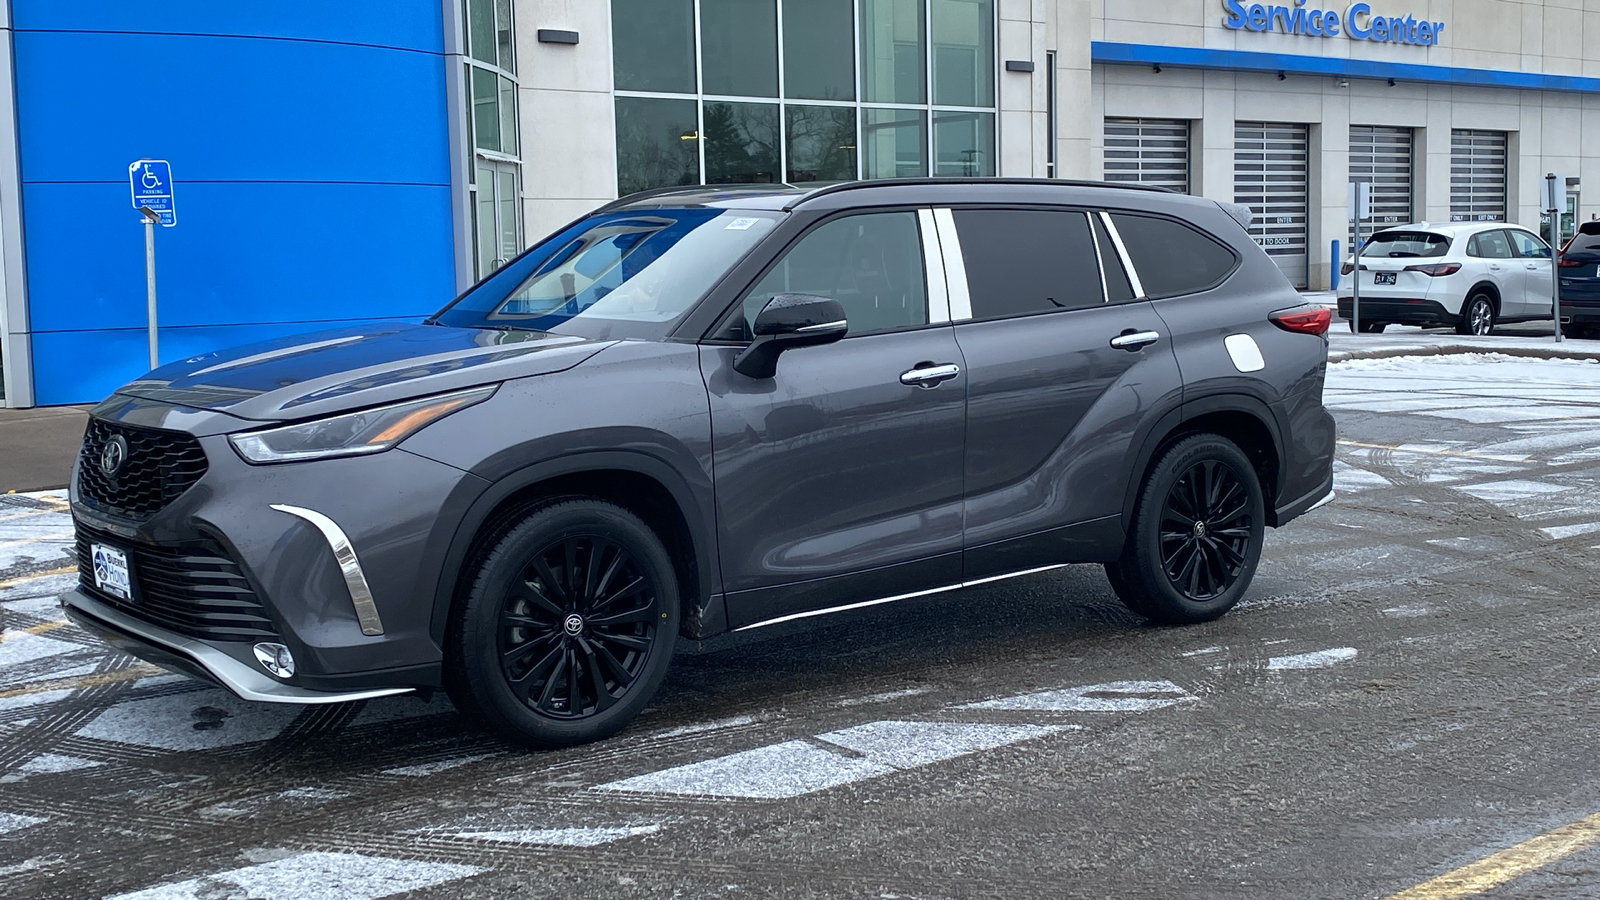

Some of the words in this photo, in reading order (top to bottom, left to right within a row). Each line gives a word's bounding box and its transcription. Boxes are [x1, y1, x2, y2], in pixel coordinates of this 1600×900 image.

[1223, 0, 1339, 37] Service
[1344, 3, 1444, 44] Center
[106, 553, 127, 569] BUERKL
[108, 564, 128, 586] HOND
